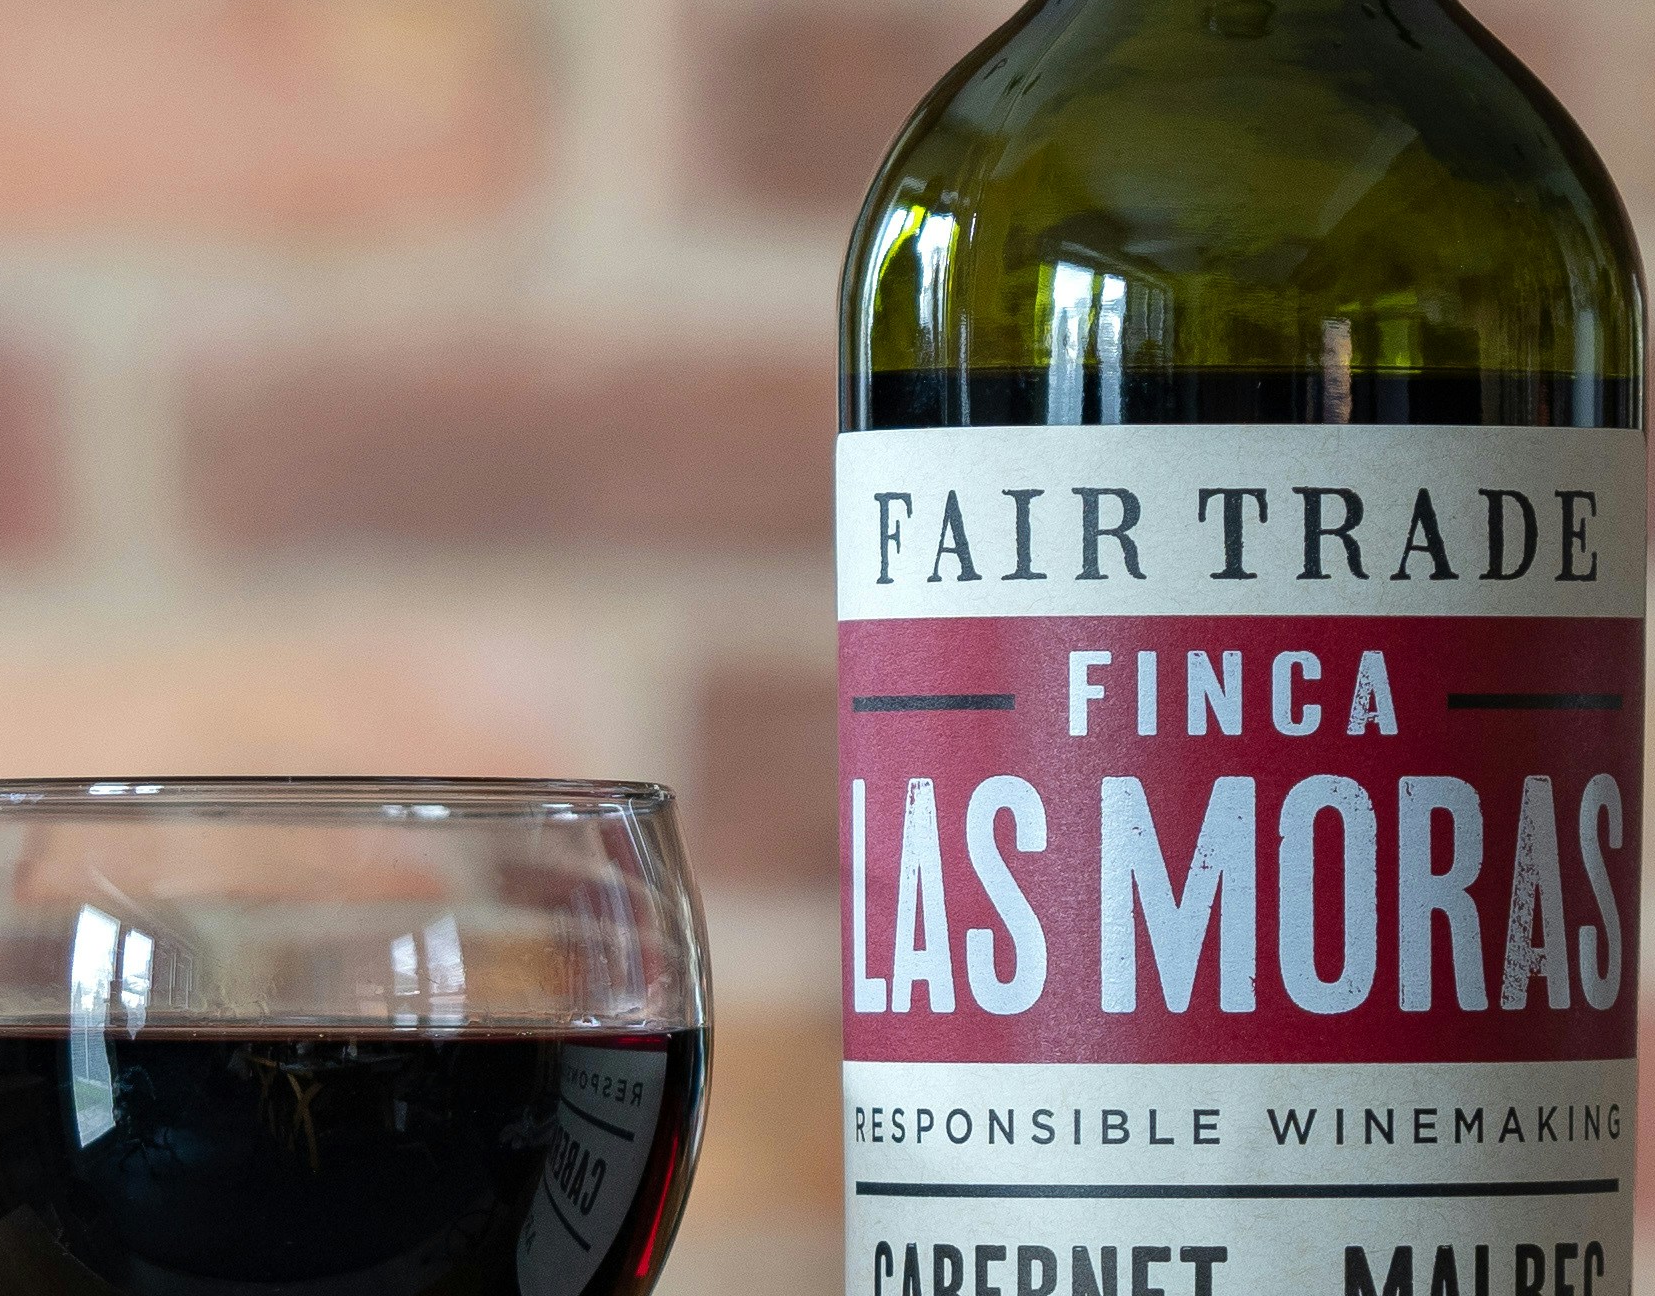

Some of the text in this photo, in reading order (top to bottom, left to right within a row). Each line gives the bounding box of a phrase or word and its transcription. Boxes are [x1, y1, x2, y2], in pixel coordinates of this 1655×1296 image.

[873, 486, 1599, 585] FAIR TRADE
[1067, 649, 1400, 738] FINCA
[851, 773, 1624, 1016] LAS MORAS
[854, 1102, 1623, 1146] RESPONSIBLE WINEMAKING
